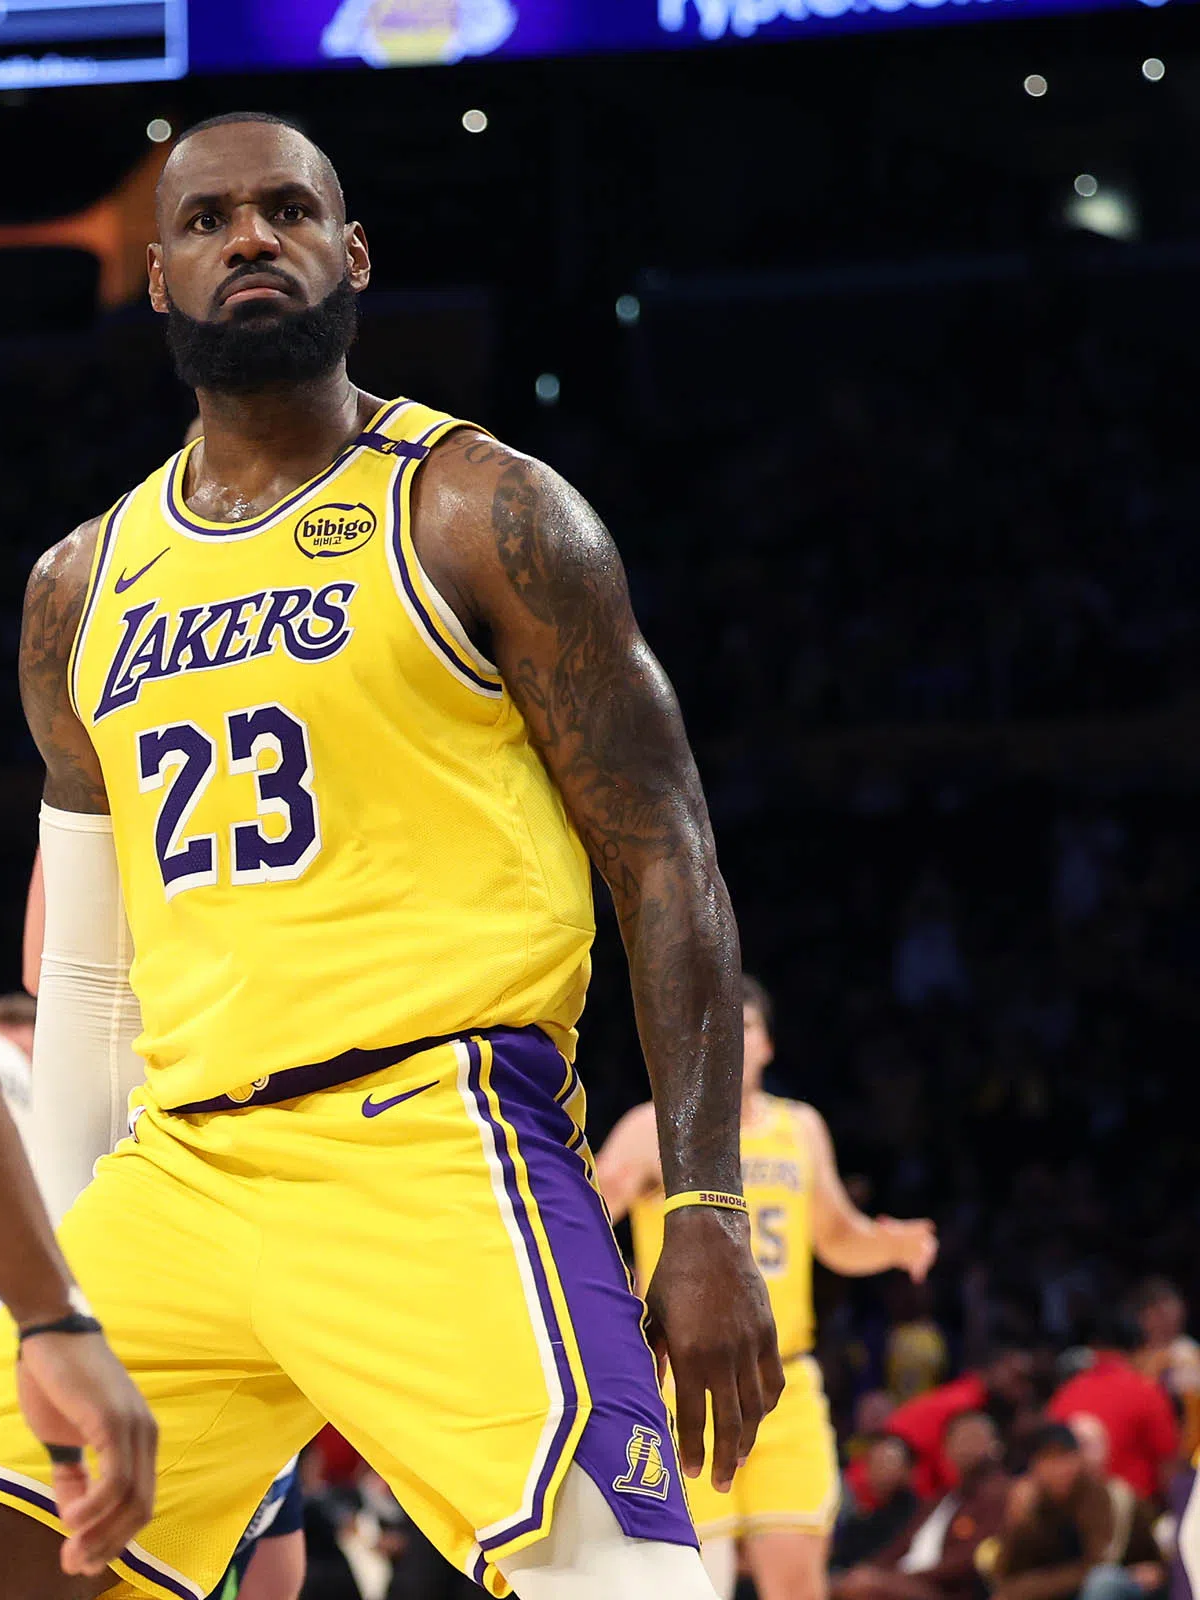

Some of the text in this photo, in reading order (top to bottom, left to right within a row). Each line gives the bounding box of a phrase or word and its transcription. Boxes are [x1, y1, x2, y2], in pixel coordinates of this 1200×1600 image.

[302, 517, 372, 540] bibigo
[313, 536, 342, 547] 비비고
[92, 581, 359, 726] LAKERS
[135, 702, 321, 900] 23
[698, 1193, 747, 1208] PROMISE
